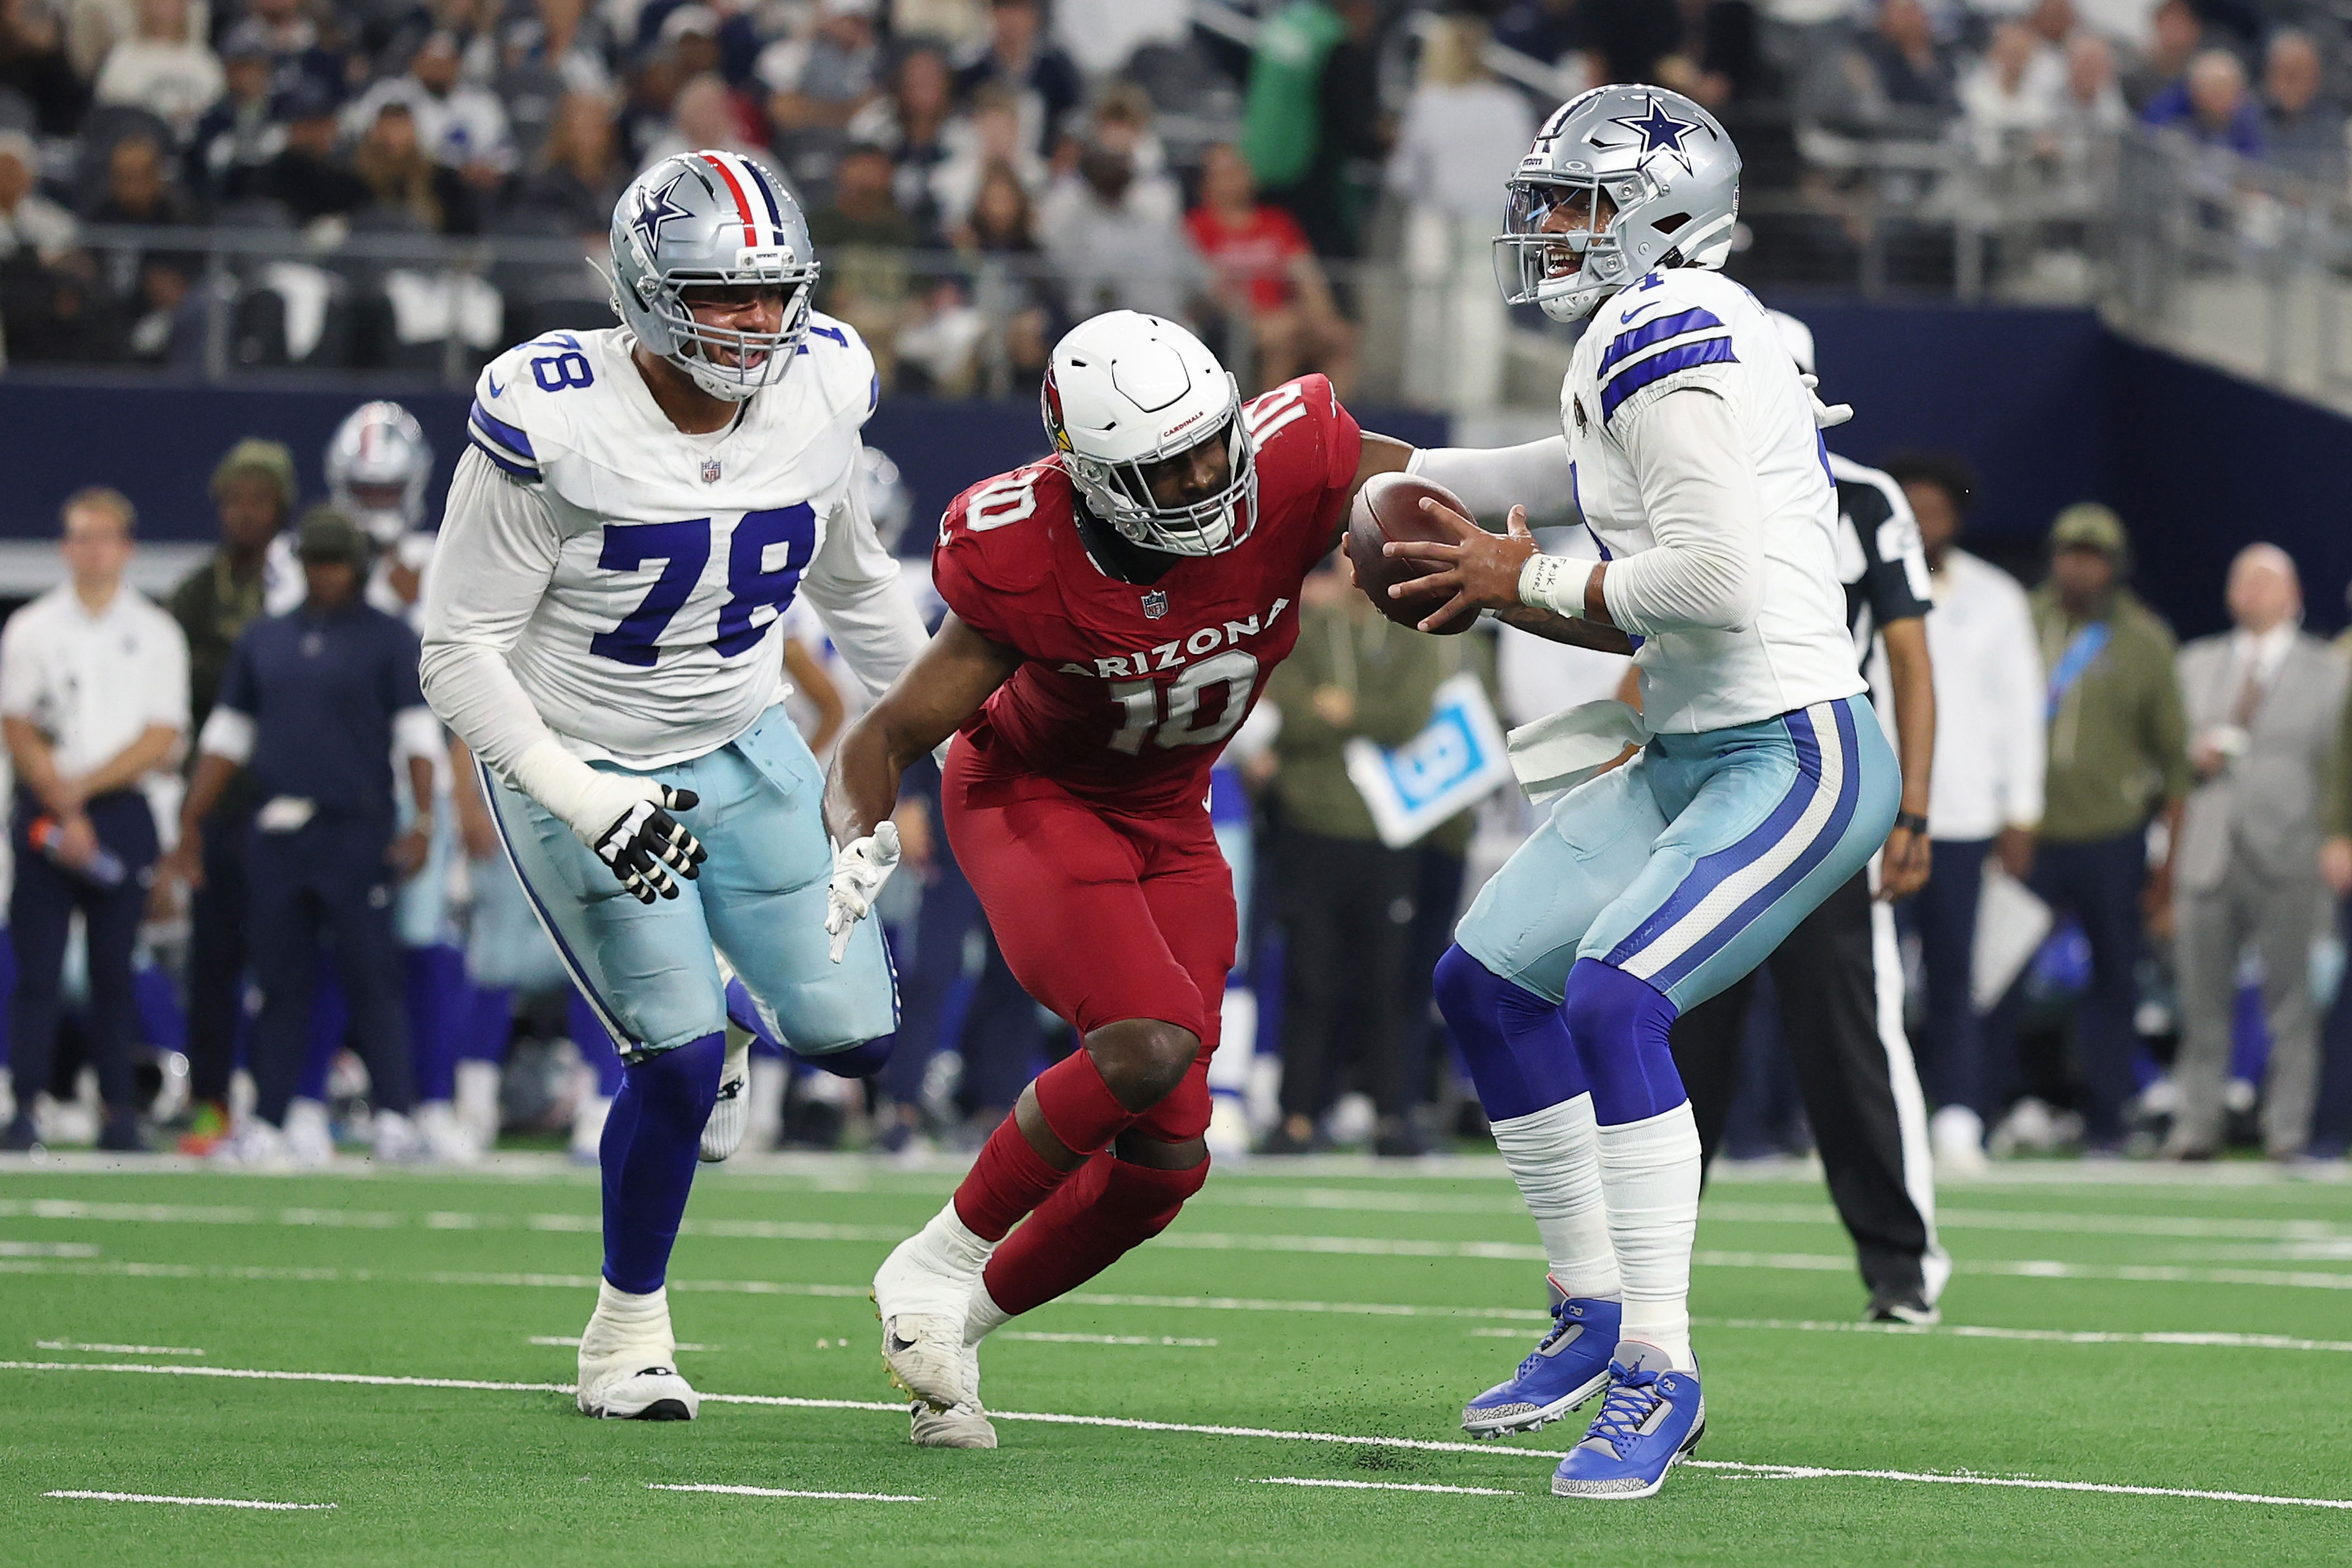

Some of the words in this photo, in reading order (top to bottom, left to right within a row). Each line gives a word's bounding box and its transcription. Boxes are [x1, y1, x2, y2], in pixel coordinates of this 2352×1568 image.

[512, 333, 594, 393] 78
[1164, 411, 1204, 437] CARDINALS
[703, 469, 720, 481] NFL
[966, 471, 1040, 532] 10
[589, 500, 815, 667] 78
[1146, 603, 1166, 616] NFL
[1057, 598, 1290, 678] ARIZONA
[1107, 648, 1259, 755] 10
